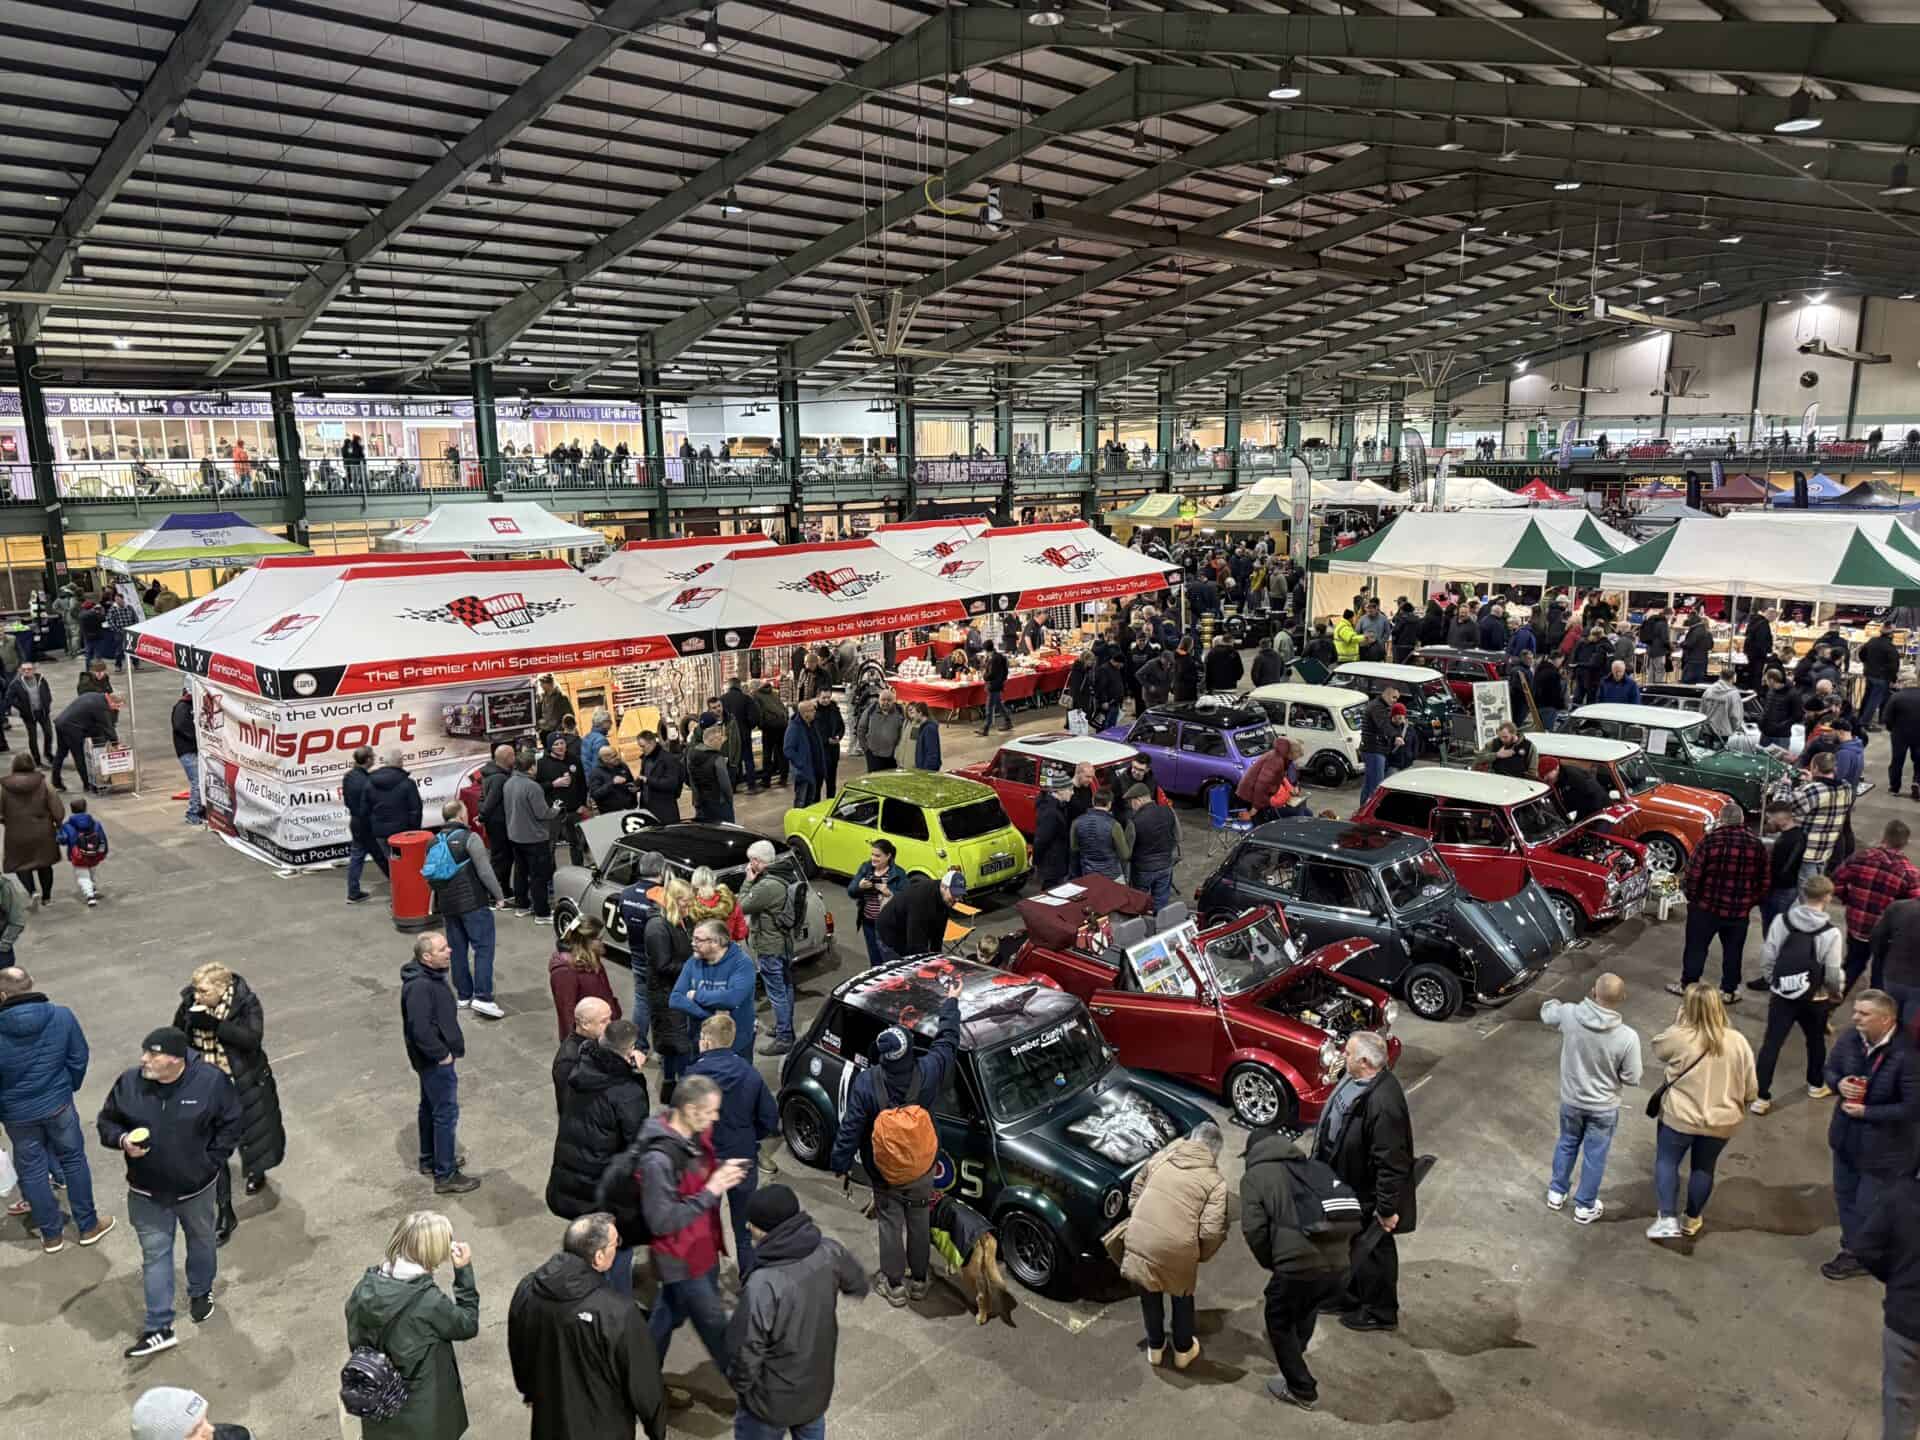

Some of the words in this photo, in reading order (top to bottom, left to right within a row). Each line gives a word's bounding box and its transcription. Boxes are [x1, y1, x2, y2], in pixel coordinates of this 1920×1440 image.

[69, 398, 135, 414] BREAKFAST
[1526, 465, 1561, 477] ARMS
[1037, 592, 1062, 603] Quality
[1064, 589, 1079, 599] Mini
[1080, 586, 1100, 597] Parts
[1101, 585, 1115, 593] You
[1116, 583, 1129, 592] Can
[1129, 580, 1148, 590] Trust
[483, 594, 524, 615] MINI
[493, 609, 531, 629] SPORT
[773, 626, 822, 640] Welcome
[823, 624, 835, 634] to
[837, 621, 854, 633] the
[856, 617, 886, 630] World
[887, 615, 898, 626] of
[900, 611, 919, 624] Mini
[920, 607, 949, 621] Sport
[364, 671, 400, 683] The
[403, 664, 468, 679] Premier
[472, 659, 505, 672] Mini
[508, 651, 579, 669] Specialist
[582, 648, 621, 661] Since
[622, 644, 652, 656] 1967
[286, 708, 316, 722] the
[321, 699, 373, 718] World
[377, 698, 394, 712] of
[239, 713, 417, 765] minisport
[418, 747, 446, 759] 1967
[245, 777, 260, 795] The
[261, 783, 286, 807] Classic
[289, 788, 331, 807] Mini
[295, 852, 307, 864] at
[1780, 971, 1810, 992] NIKE
